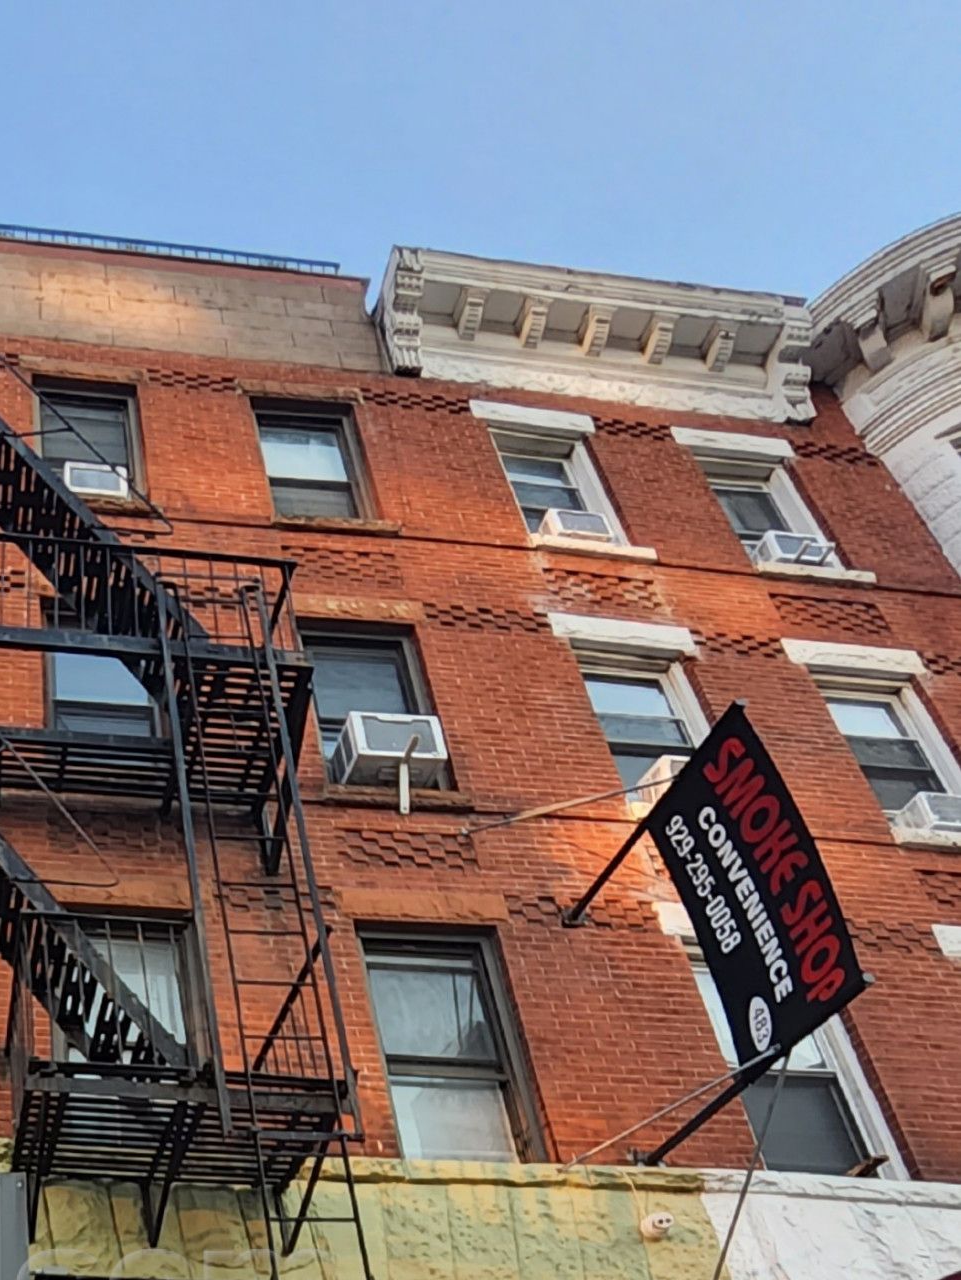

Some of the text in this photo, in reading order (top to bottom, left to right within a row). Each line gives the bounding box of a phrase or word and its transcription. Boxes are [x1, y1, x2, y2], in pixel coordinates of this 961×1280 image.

[665, 814, 742, 955] 929-295-0058
[697, 805, 794, 1004] CONVENIENCE
[702, 737, 846, 1003] SMOKE SHOP
[753, 1008, 769, 1044] 483
